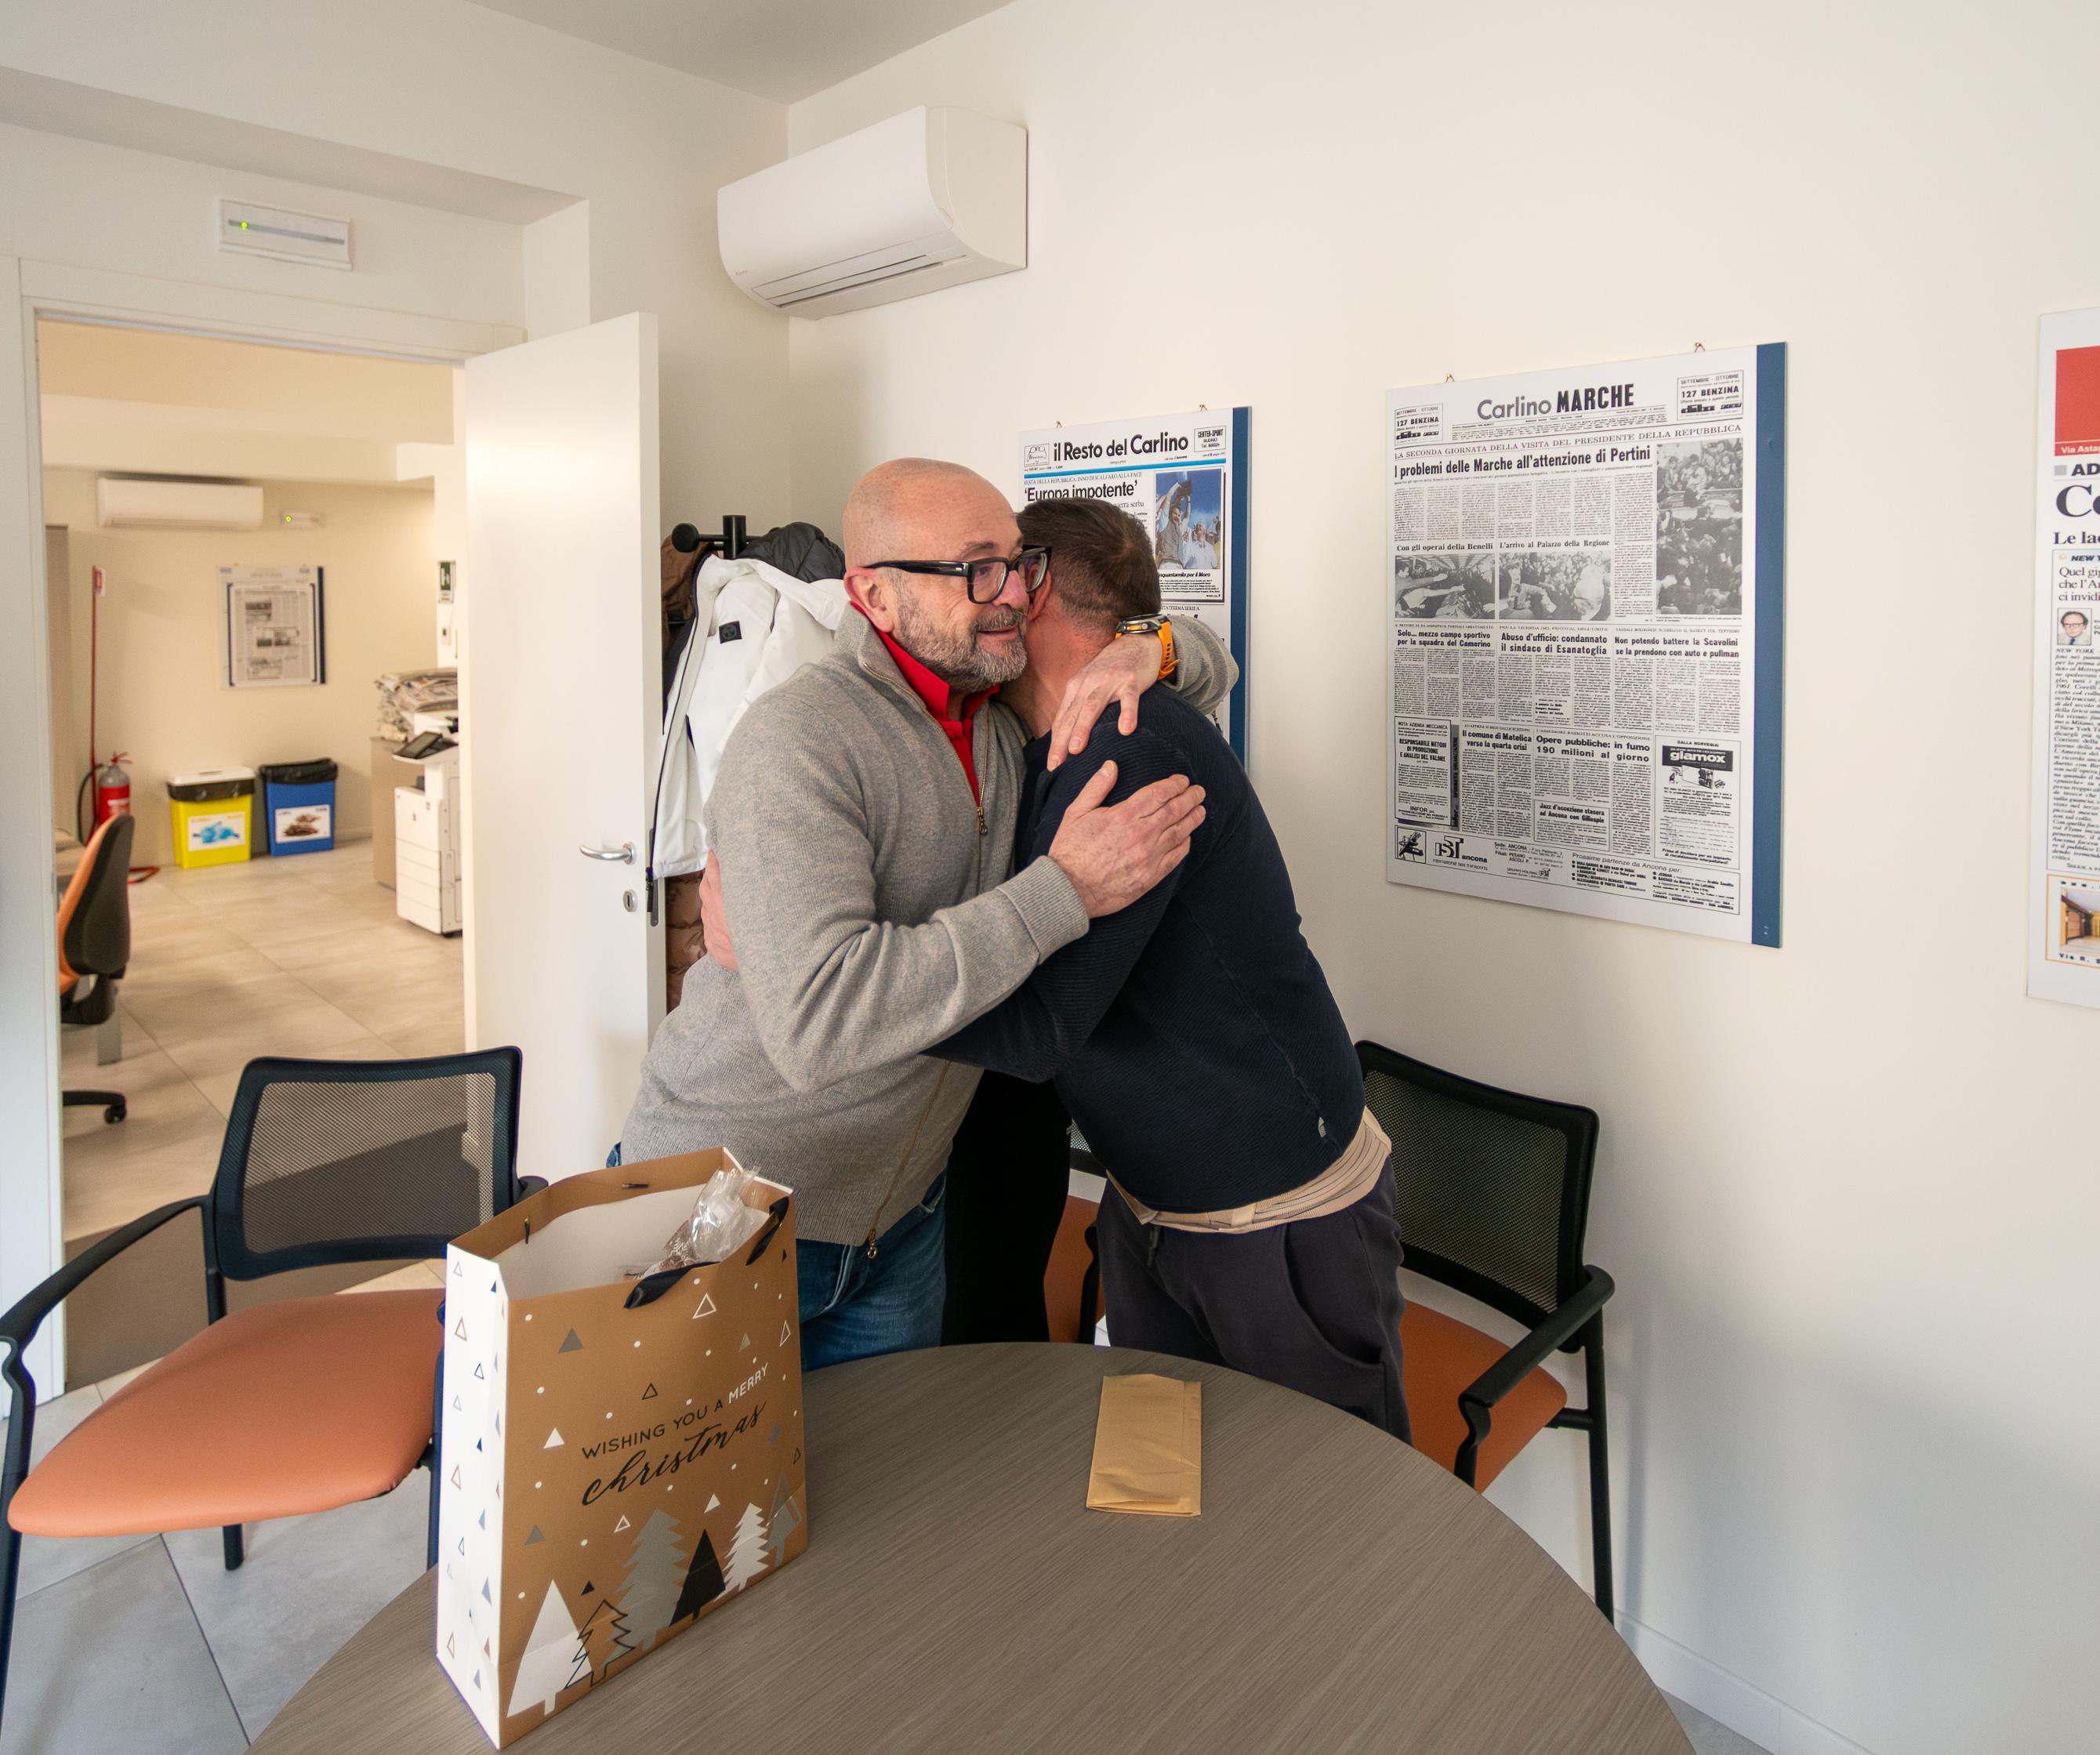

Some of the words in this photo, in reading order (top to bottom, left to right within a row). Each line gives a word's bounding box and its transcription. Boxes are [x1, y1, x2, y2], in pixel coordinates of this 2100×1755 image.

[1701, 386, 1739, 397] BENZINA
[1478, 396, 1551, 420] Carlino
[1557, 384, 1634, 413] MARCHE
[1054, 442, 1061, 461] il
[1065, 442, 1103, 460] Resto
[1107, 439, 1127, 456] del
[1130, 432, 1188, 454] Carlino
[1445, 447, 1487, 455] GIORNATA
[1521, 441, 1550, 449] VISITA
[1575, 434, 1635, 445] PRESIDENTE
[1638, 431, 1671, 440] DELLA
[1675, 425, 1741, 437] REPUBBLICA
[1395, 466, 1398, 478] I
[1400, 461, 1442, 480] problemi
[1445, 459, 1470, 473] delle
[1474, 456, 1513, 472] Marche
[1517, 451, 1591, 470] all'attenzione
[1596, 448, 1606, 463] di
[1611, 445, 1651, 462] Pertini
[2053, 532, 2076, 545] Le
[2059, 567, 2085, 578] Quel
[2058, 580, 2078, 589] che
[2058, 593, 2068, 601] ci
[1501, 633, 1524, 641] Abuso
[1526, 633, 1559, 642] d'ufficio:
[1561, 635, 1607, 644] condannato
[1501, 643, 1506, 651] il
[1546, 644, 1553, 653] di
[1557, 644, 1607, 656] Esanatoglia
[1503, 734, 1532, 742] Matelica
[1536, 735, 1561, 745] Opere
[1565, 738, 1611, 749] pubbliche:
[1627, 742, 1650, 752] fumo
[1561, 748, 1594, 757] milioni
[1670, 751, 1725, 763] glamox
[1461, 854, 1488, 863] ancona
[1572, 853, 1601, 861] Prossime
[1602, 858, 1630, 867] partenze
[1641, 862, 1667, 872] Ancona
[582, 1424, 666, 1459] WISHING
[674, 1406, 707, 1430] YOU
[715, 1400, 723, 1412] A
[729, 1362, 768, 1404] MERRY
[582, 1401, 767, 1506] christmas
